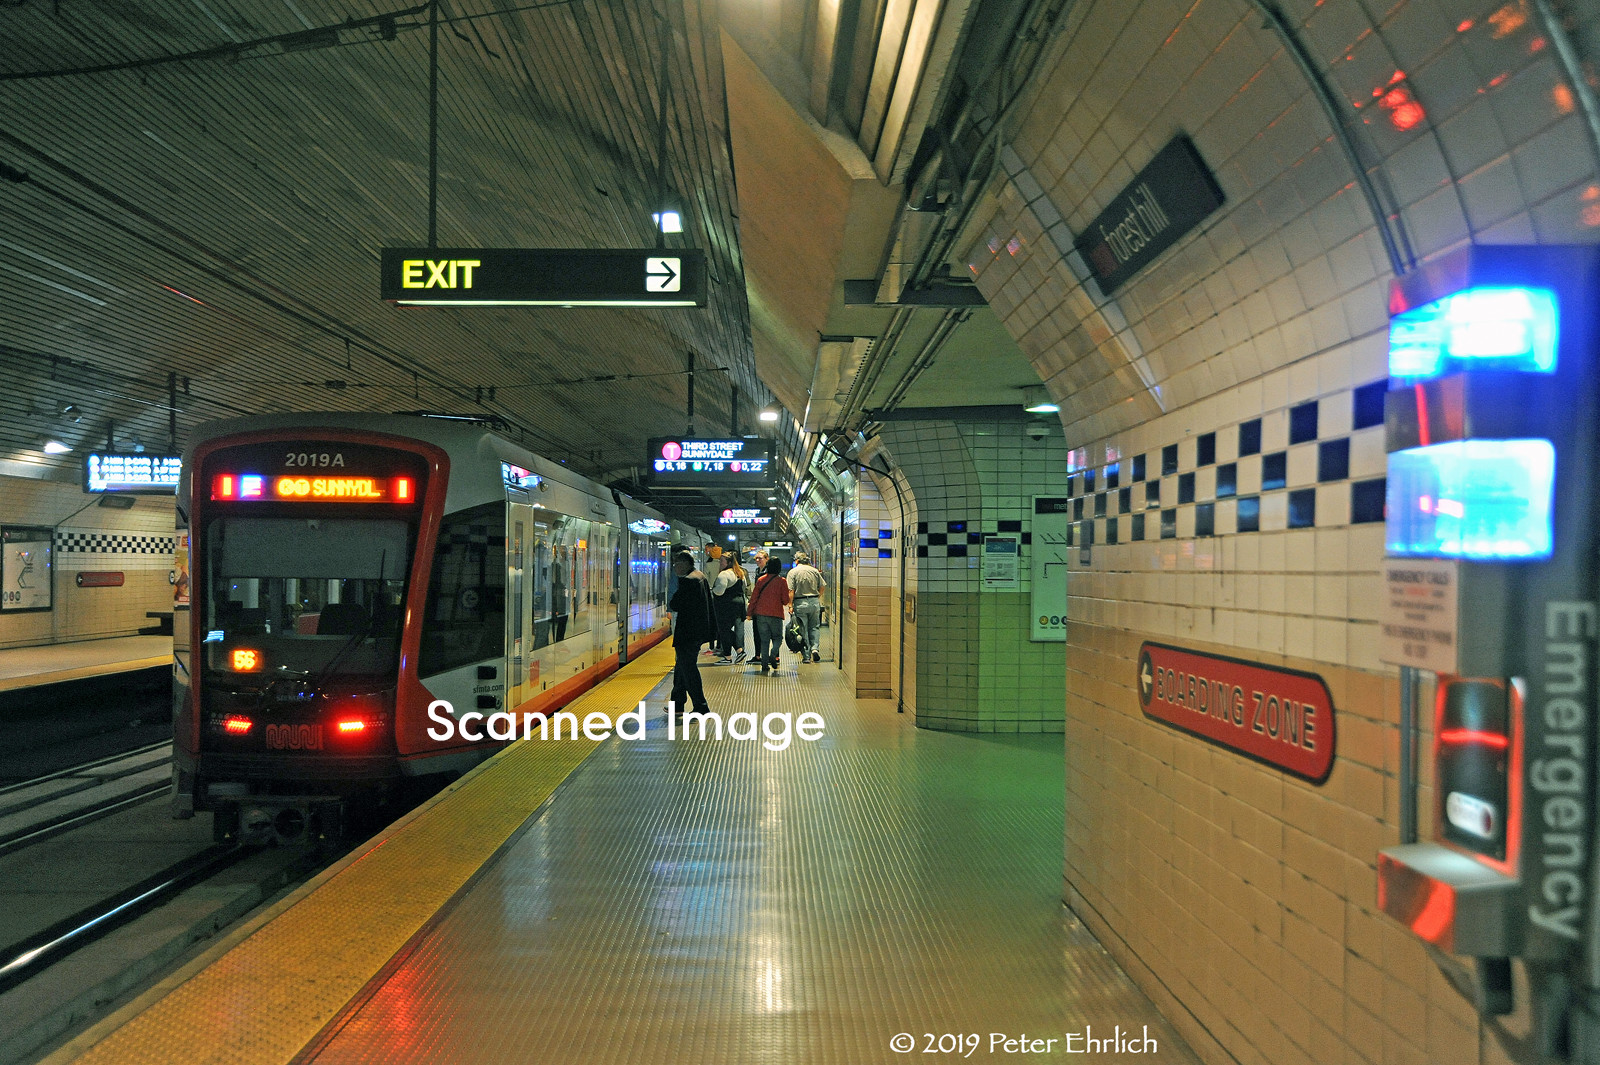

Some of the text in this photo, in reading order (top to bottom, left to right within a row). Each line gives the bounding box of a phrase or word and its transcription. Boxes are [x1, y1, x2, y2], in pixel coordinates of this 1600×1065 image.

[1100, 182, 1170, 264] forest hill
[402, 259, 481, 289] EXIT
[681, 442, 744, 451] THIRD STREET
[682, 450, 734, 459] SUNNYDALE
[285, 453, 345, 467] 2019A
[234, 650, 255, 670] 56
[473, 684, 504, 693] sfmta.com
[1157, 666, 1316, 752] BOARDING ZONE
[1529, 601, 1597, 939] Emergency
